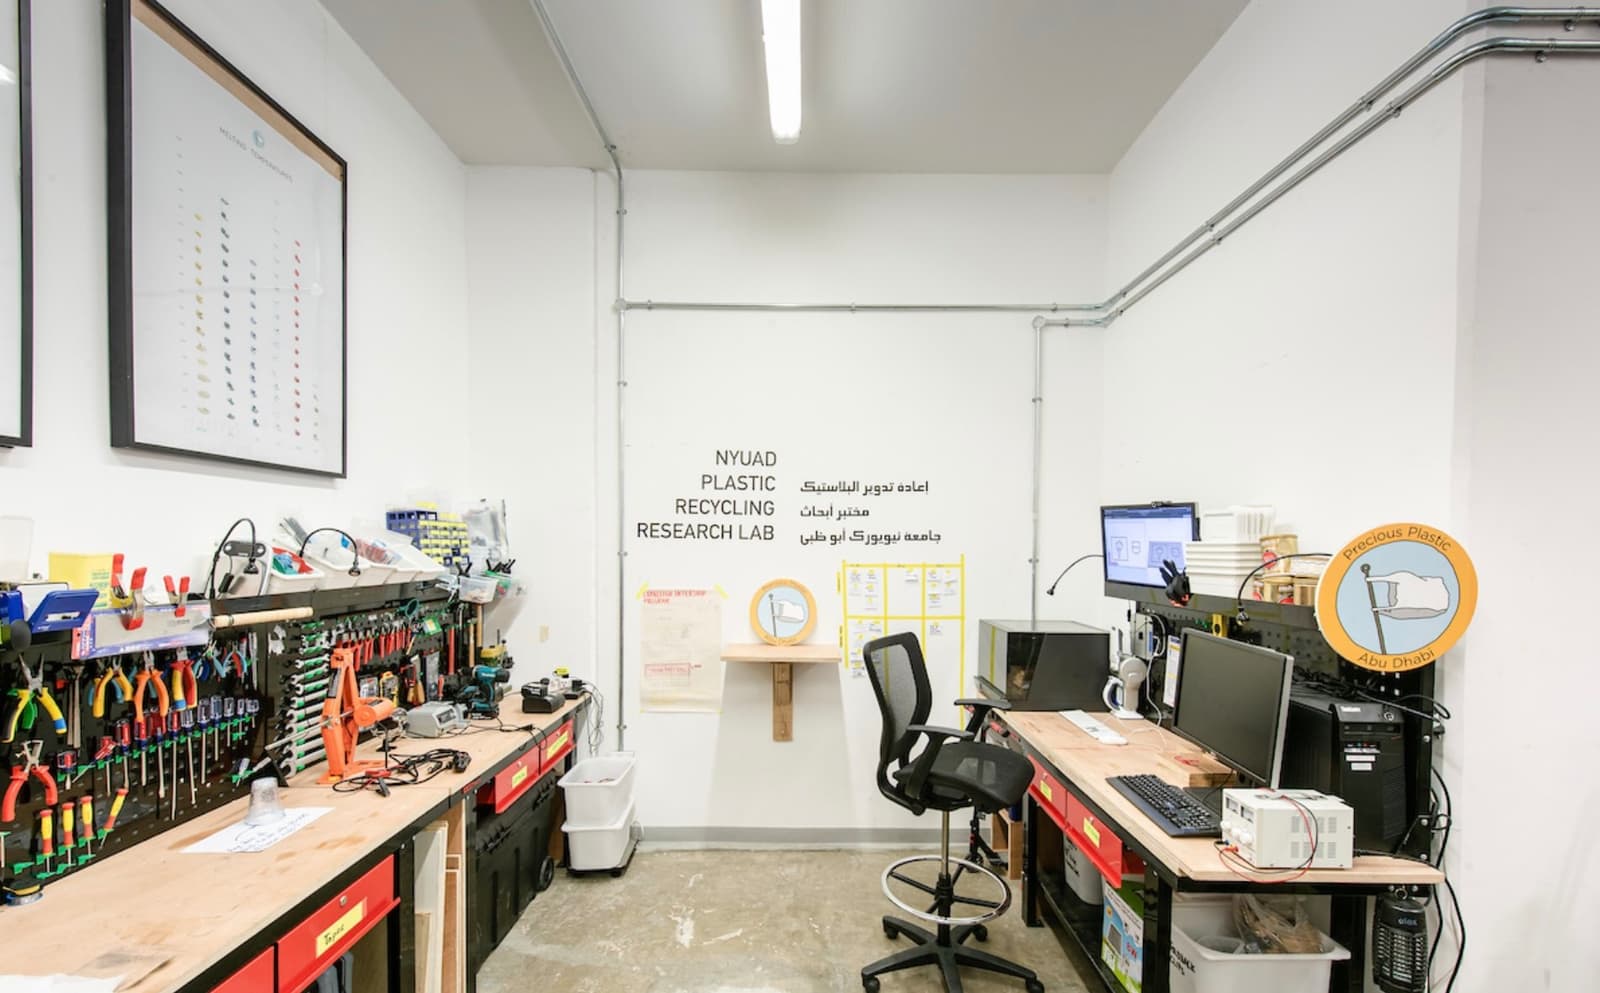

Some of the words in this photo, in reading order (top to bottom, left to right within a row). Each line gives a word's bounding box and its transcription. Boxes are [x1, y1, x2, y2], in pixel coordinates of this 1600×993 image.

[715, 449, 777, 467] NYUAD
[701, 473, 777, 492] PLASTIC
[862, 481, 895, 497] تدوير
[675, 497, 775, 517] RECYCLING
[799, 502, 834, 521] أبحاث
[836, 506, 870, 521] مختبر
[636, 521, 733, 541] RESEARCH
[738, 523, 775, 541] LAB
[830, 527, 846, 546] أبو
[848, 529, 902, 546] نيويورك
[903, 529, 942, 545] جامعة
[1343, 527, 1403, 561] Precious
[1407, 526, 1452, 551] Plastic
[1358, 652, 1388, 669] Abu
[1392, 648, 1436, 669] Dhabi
